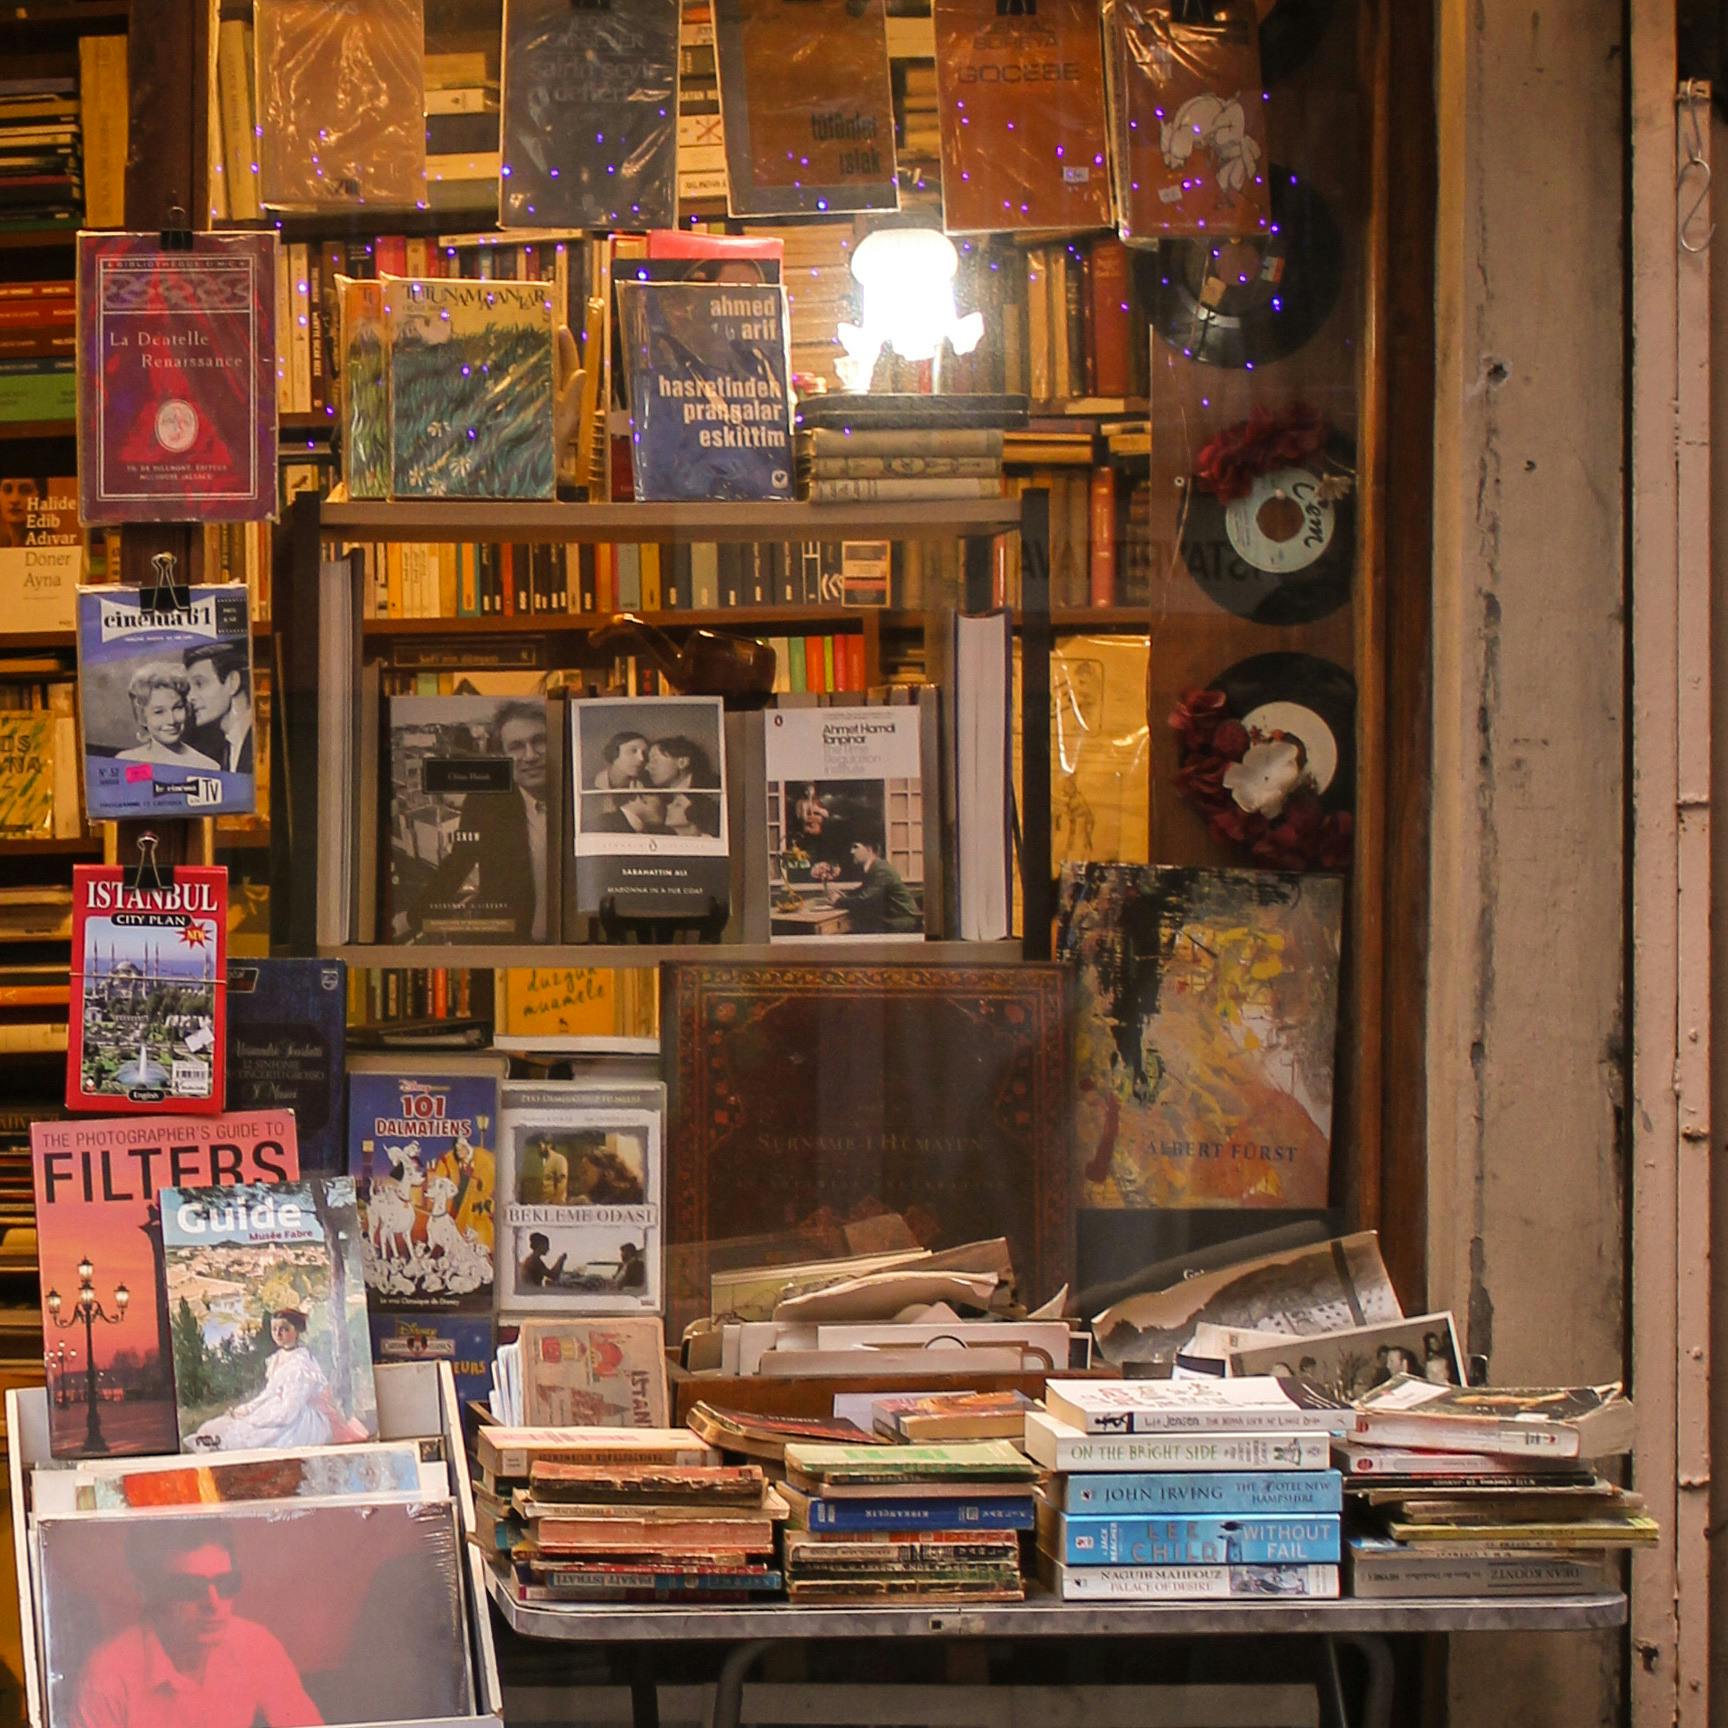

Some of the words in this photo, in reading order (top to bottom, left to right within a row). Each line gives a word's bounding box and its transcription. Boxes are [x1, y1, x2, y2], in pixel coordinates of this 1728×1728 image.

[710, 295, 776, 317] ahmed
[110, 332, 129, 348] La
[138, 330, 210, 348] Dentelle
[741, 319, 777, 341] arif
[141, 354, 244, 370] Renaissance
[658, 374, 783, 400] hasretinden
[683, 402, 784, 425] prangalar
[699, 425, 786, 448] eskittim
[25, 495, 77, 512] Halide
[25, 513, 61, 529] Edib
[23, 573, 63, 592] Ayna
[823, 723, 859, 735] Ahmet
[202, 779, 221, 802] TV
[86, 879, 218, 911] ISTANBUL
[116, 914, 146, 926] CITY
[149, 915, 187, 927] PLAN
[401, 1094, 446, 1119] 101
[43, 1133, 69, 1148] THE
[76, 1126, 211, 1145] PHOTOGRAPHER'S
[216, 1123, 260, 1139] GUIDE
[263, 1121, 285, 1136] TO
[375, 1118, 472, 1137] DALMATIENS
[43, 1141, 287, 1204] FILTERS
[177, 1195, 302, 1235] Guide
[509, 1208, 592, 1224] BEKLEME
[248, 1229, 282, 1242] Musée
[284, 1228, 314, 1240] Fabre
[1071, 1443, 1093, 1460] ON
[1099, 1444, 1124, 1461] THE
[1185, 1441, 1218, 1460] SIDE
[1104, 1486, 1155, 1502] JOHN
[1159, 1484, 1223, 1501] IRVING
[1236, 1482, 1258, 1494] THE
[1304, 1481, 1331, 1493] NEW
[1251, 1493, 1314, 1505] HAMPSHIRE
[1147, 1521, 1201, 1541] LEE
[1242, 1523, 1332, 1541] WITHOUT
[1129, 1542, 1220, 1564] CHILD
[1265, 1541, 1309, 1560] FAIL
[1110, 1579, 1154, 1592] PALACE
[1155, 1580, 1168, 1592] OF
[1170, 1580, 1214, 1592] DESIRE
